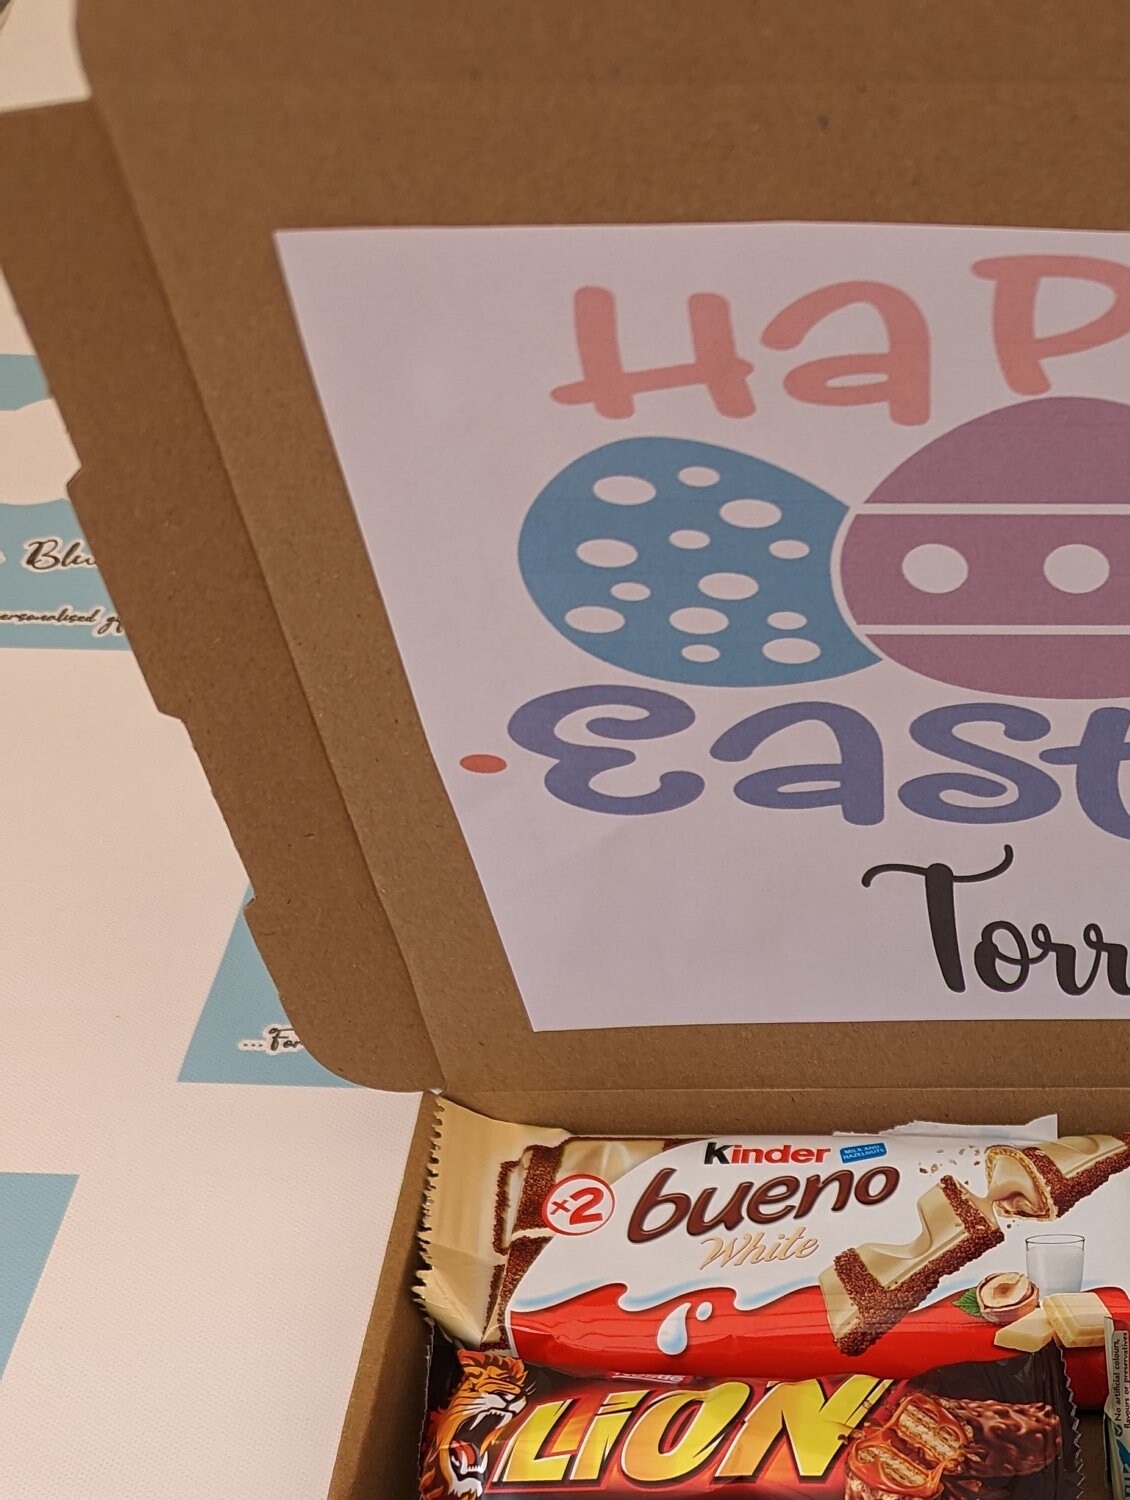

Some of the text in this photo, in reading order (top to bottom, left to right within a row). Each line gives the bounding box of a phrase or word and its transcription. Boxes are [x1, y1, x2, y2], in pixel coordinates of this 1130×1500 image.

[27, 539, 97, 570] Blu
[0, 607, 101, 623] ersonalised
[704, 1142, 831, 1165] Kinder
[627, 1166, 900, 1244] bueno
[700, 1226, 819, 1270] White
[1121, 1332, 1130, 1383] preservatives
[1113, 1372, 1122, 1406] artificial
[1124, 1386, 1130, 1395] or
[1114, 1408, 1122, 1422] No
